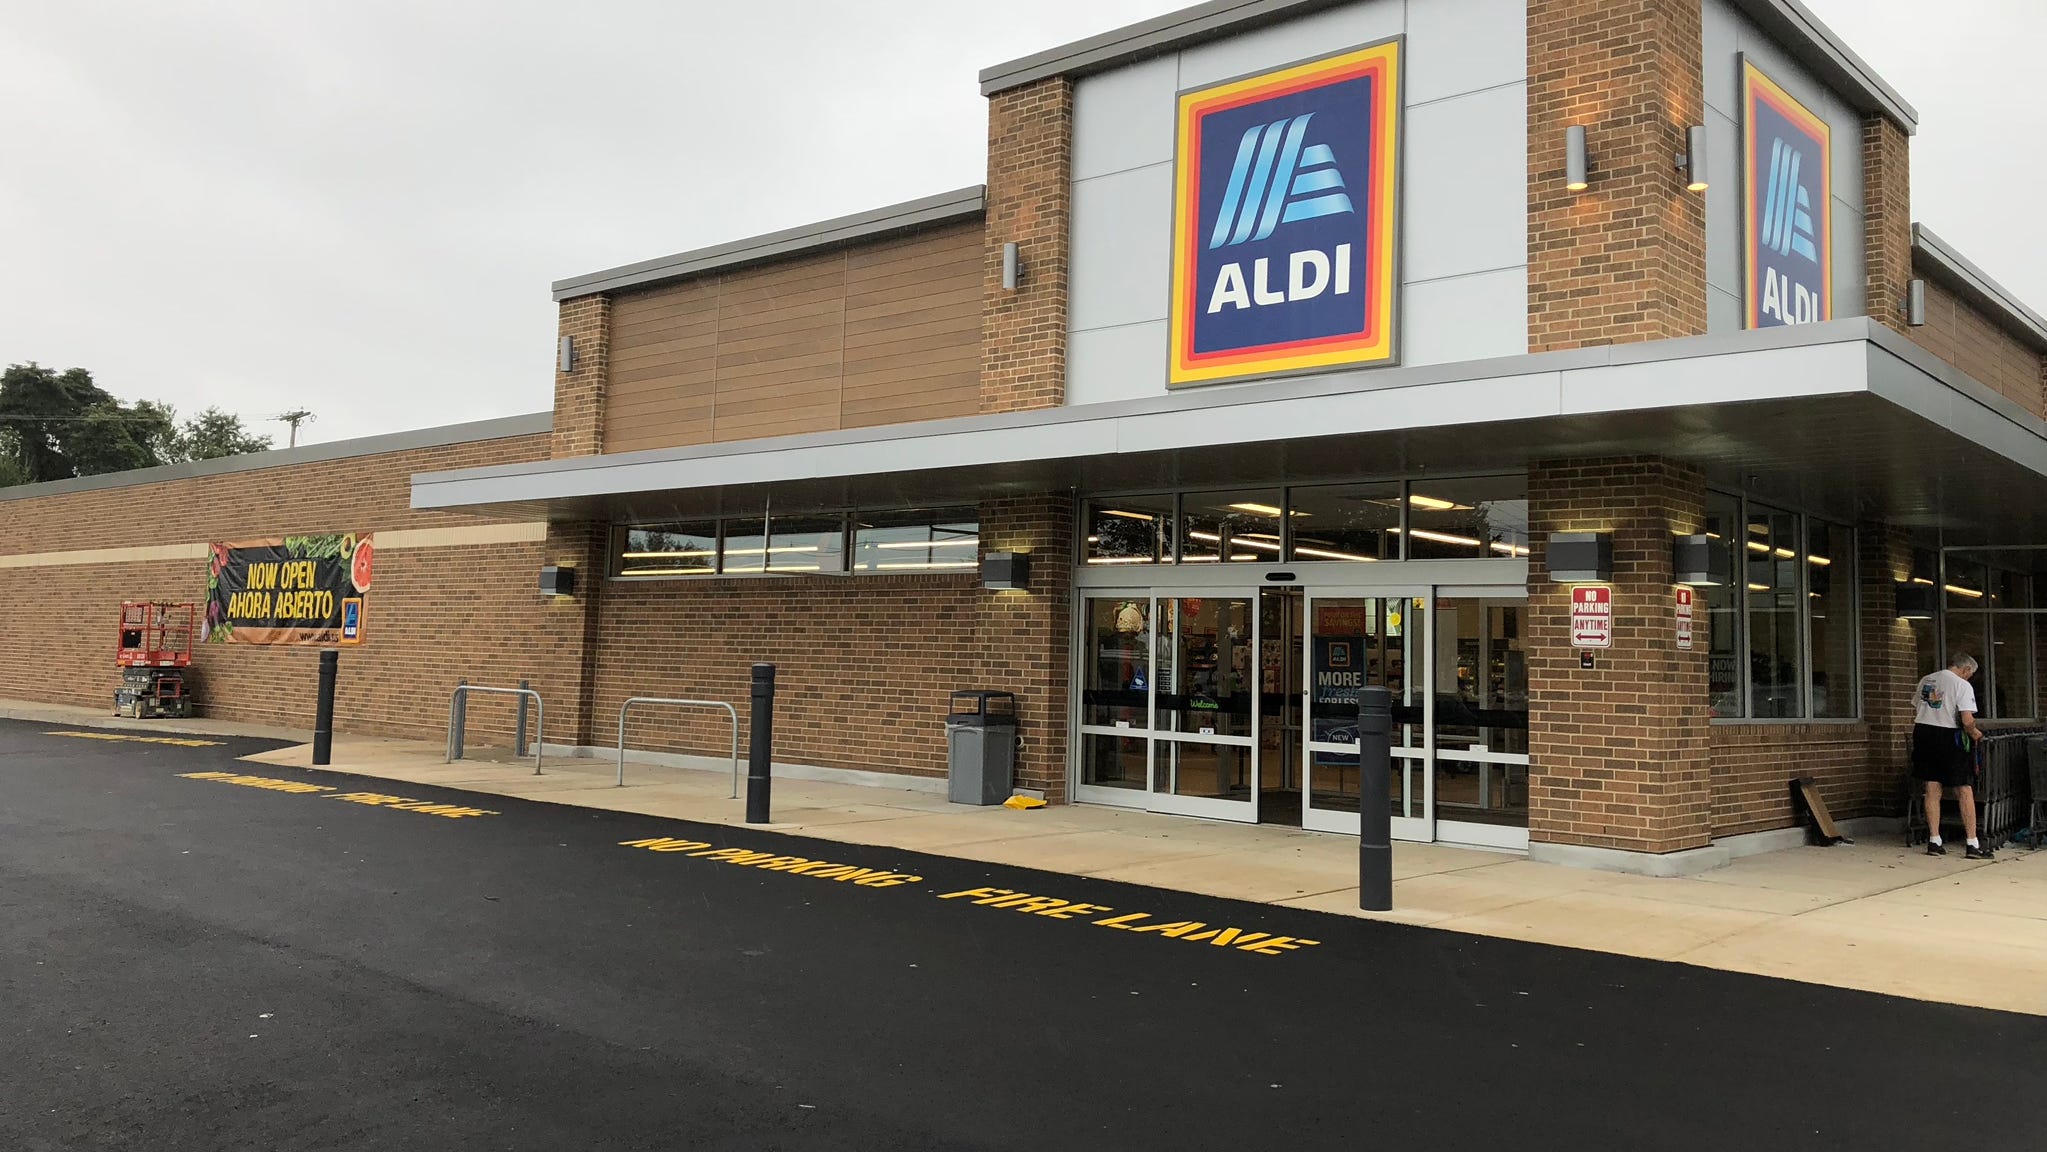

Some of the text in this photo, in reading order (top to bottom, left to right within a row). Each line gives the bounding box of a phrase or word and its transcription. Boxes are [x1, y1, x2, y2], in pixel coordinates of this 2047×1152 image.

[1207, 243, 1351, 314] ALDI
[1762, 266, 1818, 326] ALDI
[246, 561, 317, 590] NOW OPEN
[1585, 591, 1597, 602] NO
[227, 590, 334, 620] AHORA ABIERTO
[1573, 603, 1609, 614] PARKING
[1574, 619, 1608, 631] ANYTIME
[1318, 671, 1362, 686] MORE
[1190, 698, 1219, 710] Welcome
[1332, 733, 1349, 741] NEW
[617, 837, 1321, 955] NO PARKING FIRE LANE
